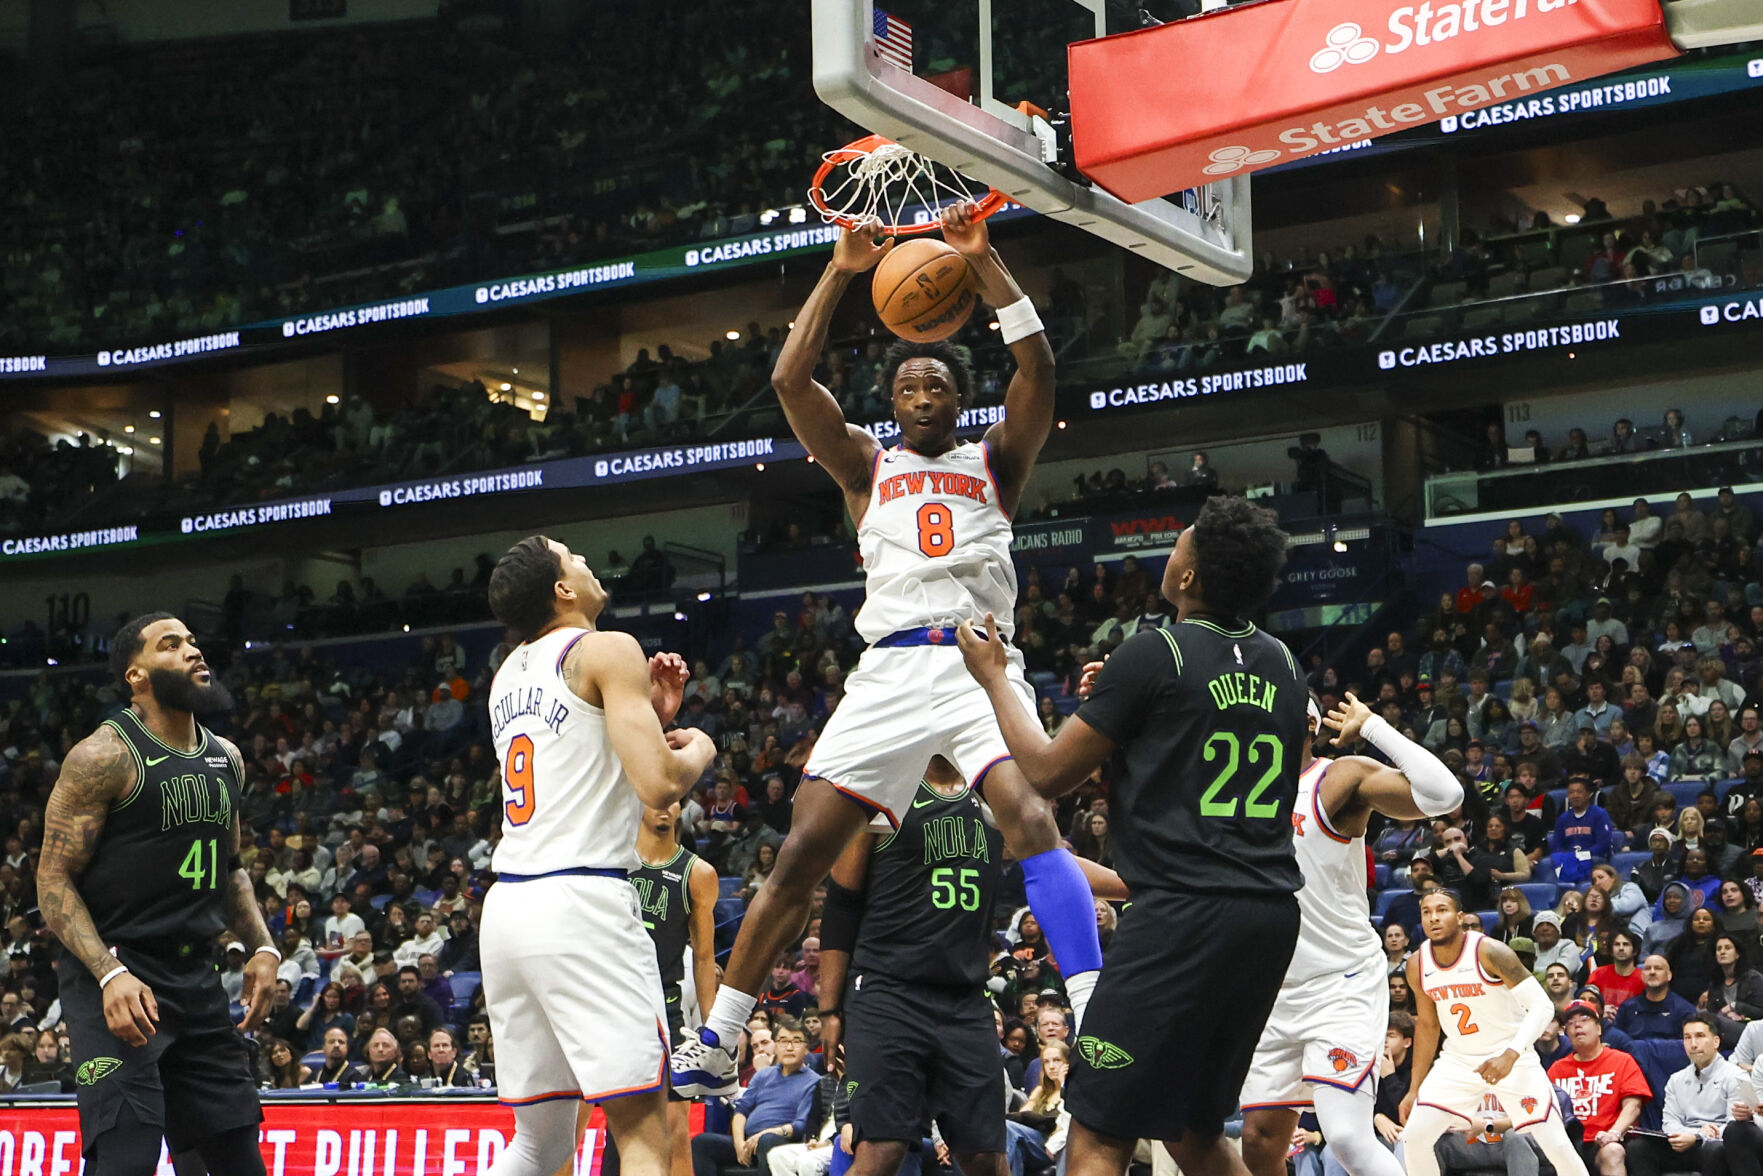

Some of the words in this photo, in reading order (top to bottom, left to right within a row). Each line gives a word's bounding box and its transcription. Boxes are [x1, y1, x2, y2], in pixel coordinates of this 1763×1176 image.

[1460, 97, 1554, 128] CAESARS
[1558, 76, 1670, 112] SPORTSBOOK
[701, 237, 771, 263] CAESARS
[773, 224, 840, 252] SPORTSBO
[490, 276, 555, 300] CAESARS
[557, 262, 634, 289] SPORTSBOOK
[296, 311, 356, 334] CAESARS
[358, 298, 428, 324] SPORTSBOOK
[113, 343, 172, 364] CAESARS
[174, 332, 239, 356] SPORTSBOOK
[1400, 337, 1497, 366] CAESARS
[1503, 320, 1619, 352] SPORTSBOOK
[1109, 379, 1197, 406] CAESARS
[1202, 364, 1306, 393] SPORTSBOOK
[611, 450, 683, 474] CAESARS
[687, 438, 773, 465] SPORTSBOOK
[394, 481, 460, 503] CAESARS
[464, 470, 542, 494] SPORTSBOOK
[879, 472, 926, 505] NEW
[928, 471, 987, 504] YORK
[195, 509, 255, 531] CAESARS
[259, 499, 330, 522] SPORTSBOOK
[916, 502, 954, 559] 8
[3, 535, 68, 554] CAESARS
[71, 527, 137, 548] SPORTSBOOK
[1051, 529, 1083, 547] RADIO
[1208, 672, 1278, 714] QUEEN
[505, 732, 536, 827] 9
[1200, 731, 1284, 819] 22
[160, 773, 231, 831] NOLA
[924, 816, 990, 865] NOLA
[178, 838, 218, 890] 41
[628, 877, 669, 921] OLA
[931, 867, 981, 911] 55
[1448, 982, 1487, 998] YORK
[1450, 1003, 1480, 1036] 2
